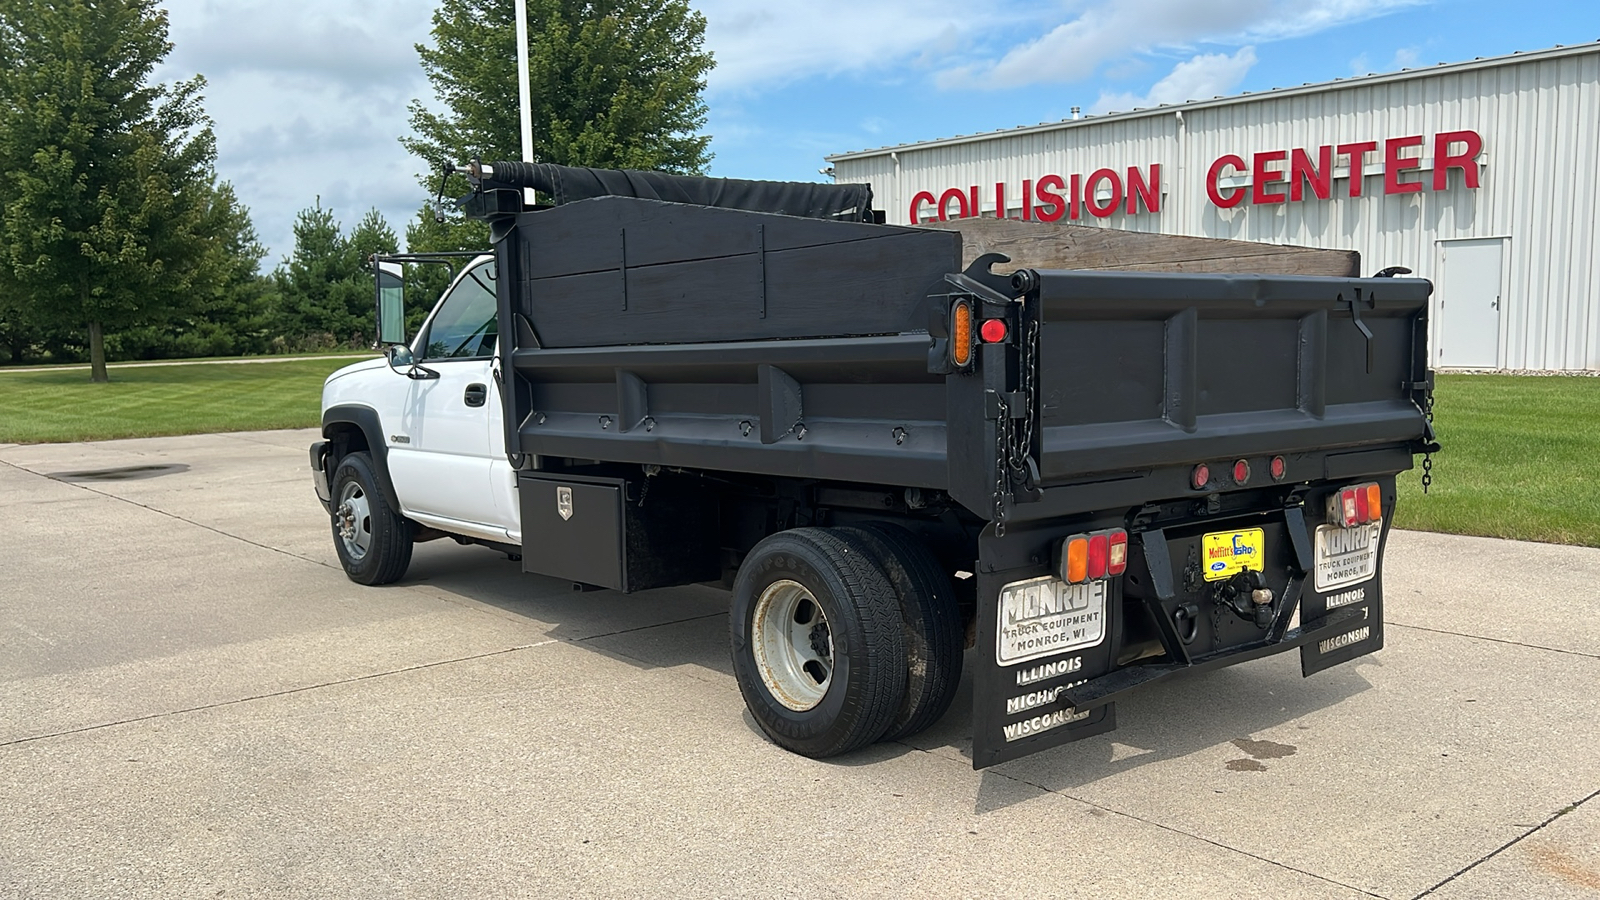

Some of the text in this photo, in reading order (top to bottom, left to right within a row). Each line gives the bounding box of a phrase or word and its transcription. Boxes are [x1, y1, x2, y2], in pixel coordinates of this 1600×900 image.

[910, 130, 1483, 224] COLLISION CENTER
[1319, 551, 1373, 571] TRUCK EQUIPMENT
[1002, 580, 1103, 621] MONROE
[1326, 588, 1365, 610] ILLINOIS
[1005, 612, 1099, 639] TRUCK EQUIPMENT
[1018, 628, 1085, 651] MONROE, WI
[1318, 626, 1369, 653] WISCONSIN
[1016, 656, 1082, 685] ILLINOIS
